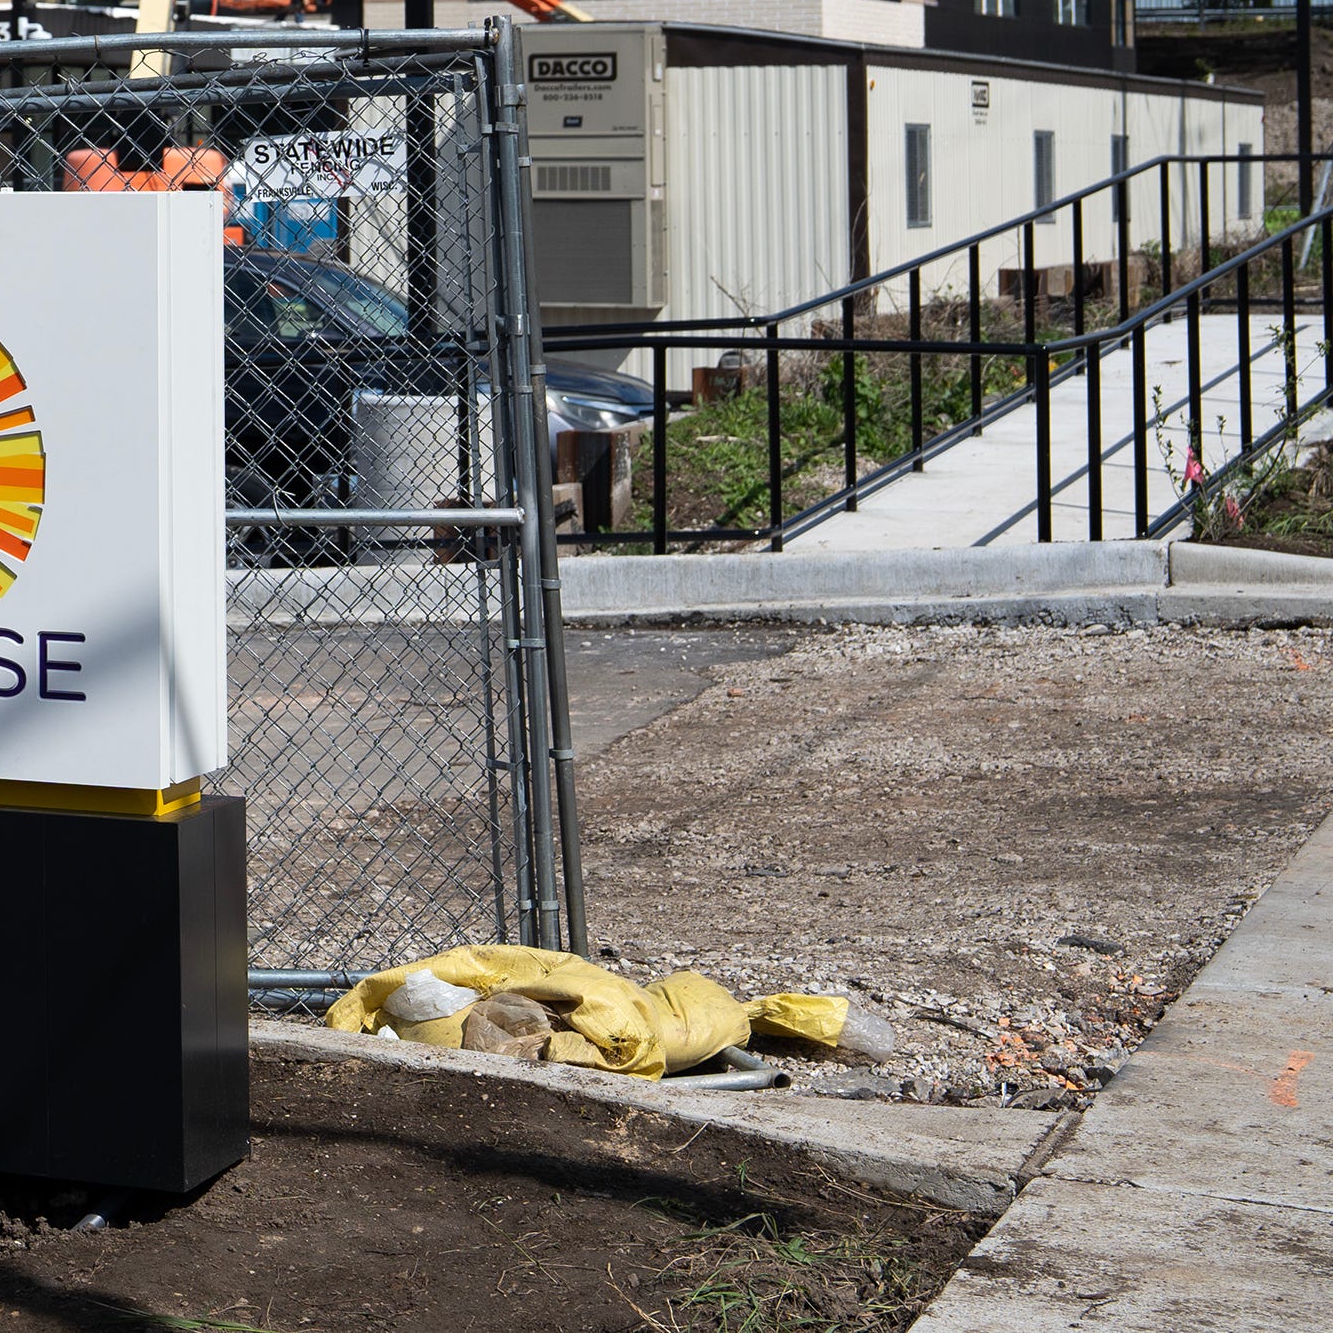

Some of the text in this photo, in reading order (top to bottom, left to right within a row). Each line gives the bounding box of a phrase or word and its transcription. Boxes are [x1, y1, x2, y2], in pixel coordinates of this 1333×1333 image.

[538, 60, 608, 76] DACCO
[254, 137, 395, 164] STATEWIDE
[291, 159, 360, 175] FENCING
